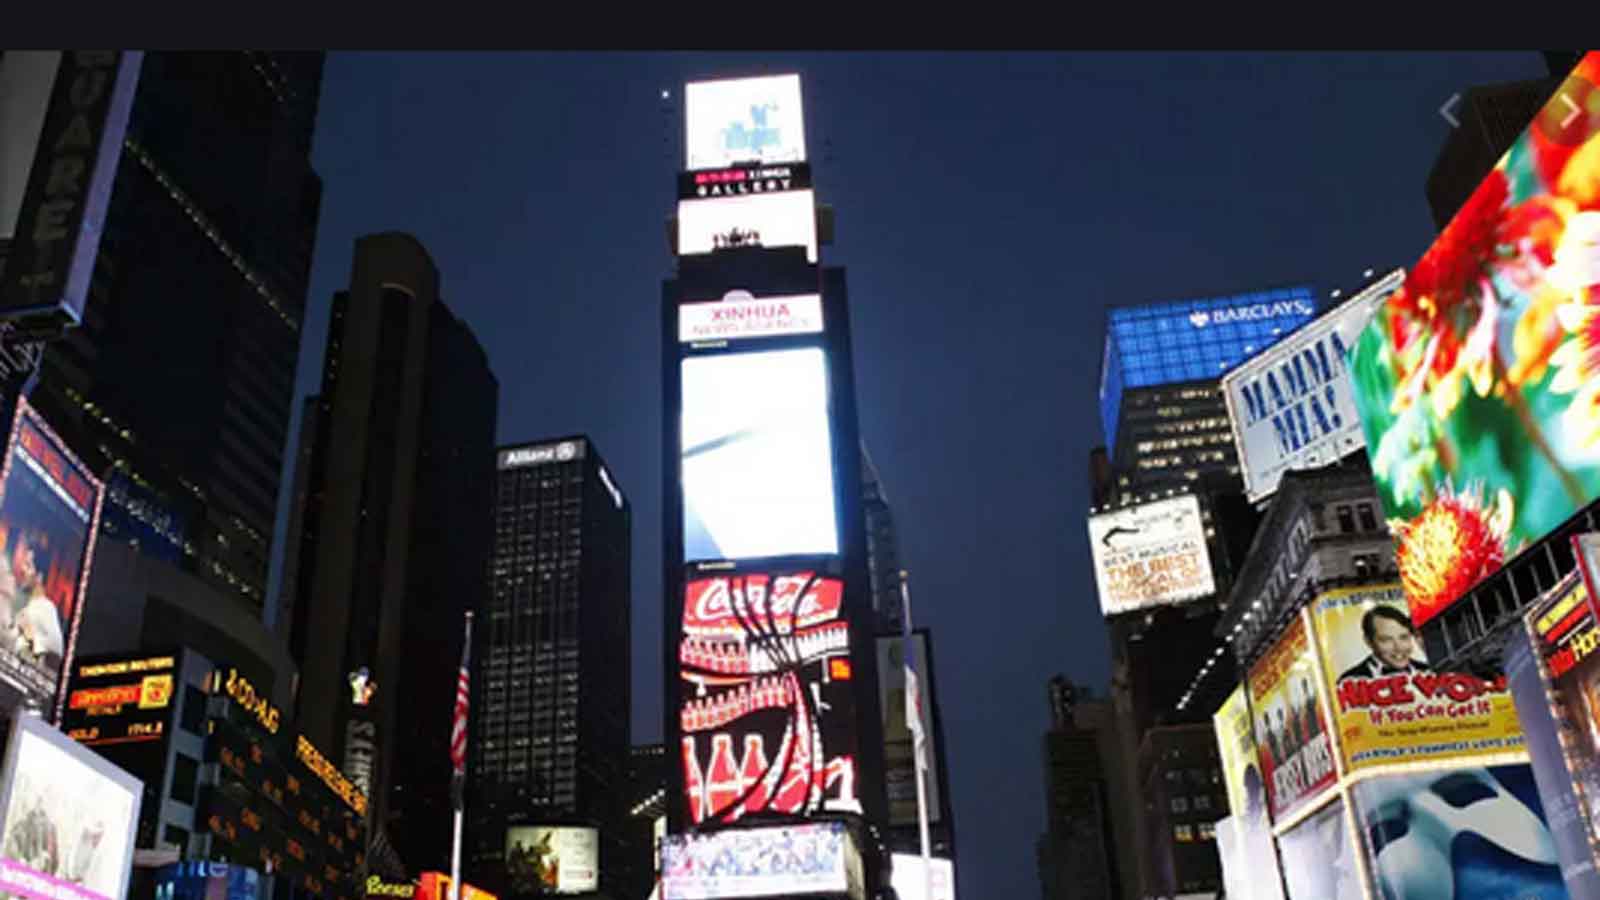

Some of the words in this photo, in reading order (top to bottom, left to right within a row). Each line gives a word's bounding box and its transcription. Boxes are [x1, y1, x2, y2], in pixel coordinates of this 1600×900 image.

[697, 180, 792, 197] GALLERY
[711, 302, 791, 322] XINHUA
[1213, 300, 1308, 324] BARCLAYS
[1272, 384, 1342, 459] MIA!
[505, 446, 556, 466] Allianz
[1337, 673, 1416, 714] NICE
[1369, 707, 1384, 725] If
[1387, 706, 1414, 722] You
[1415, 703, 1444, 719] Can
[1445, 701, 1475, 717] Get
